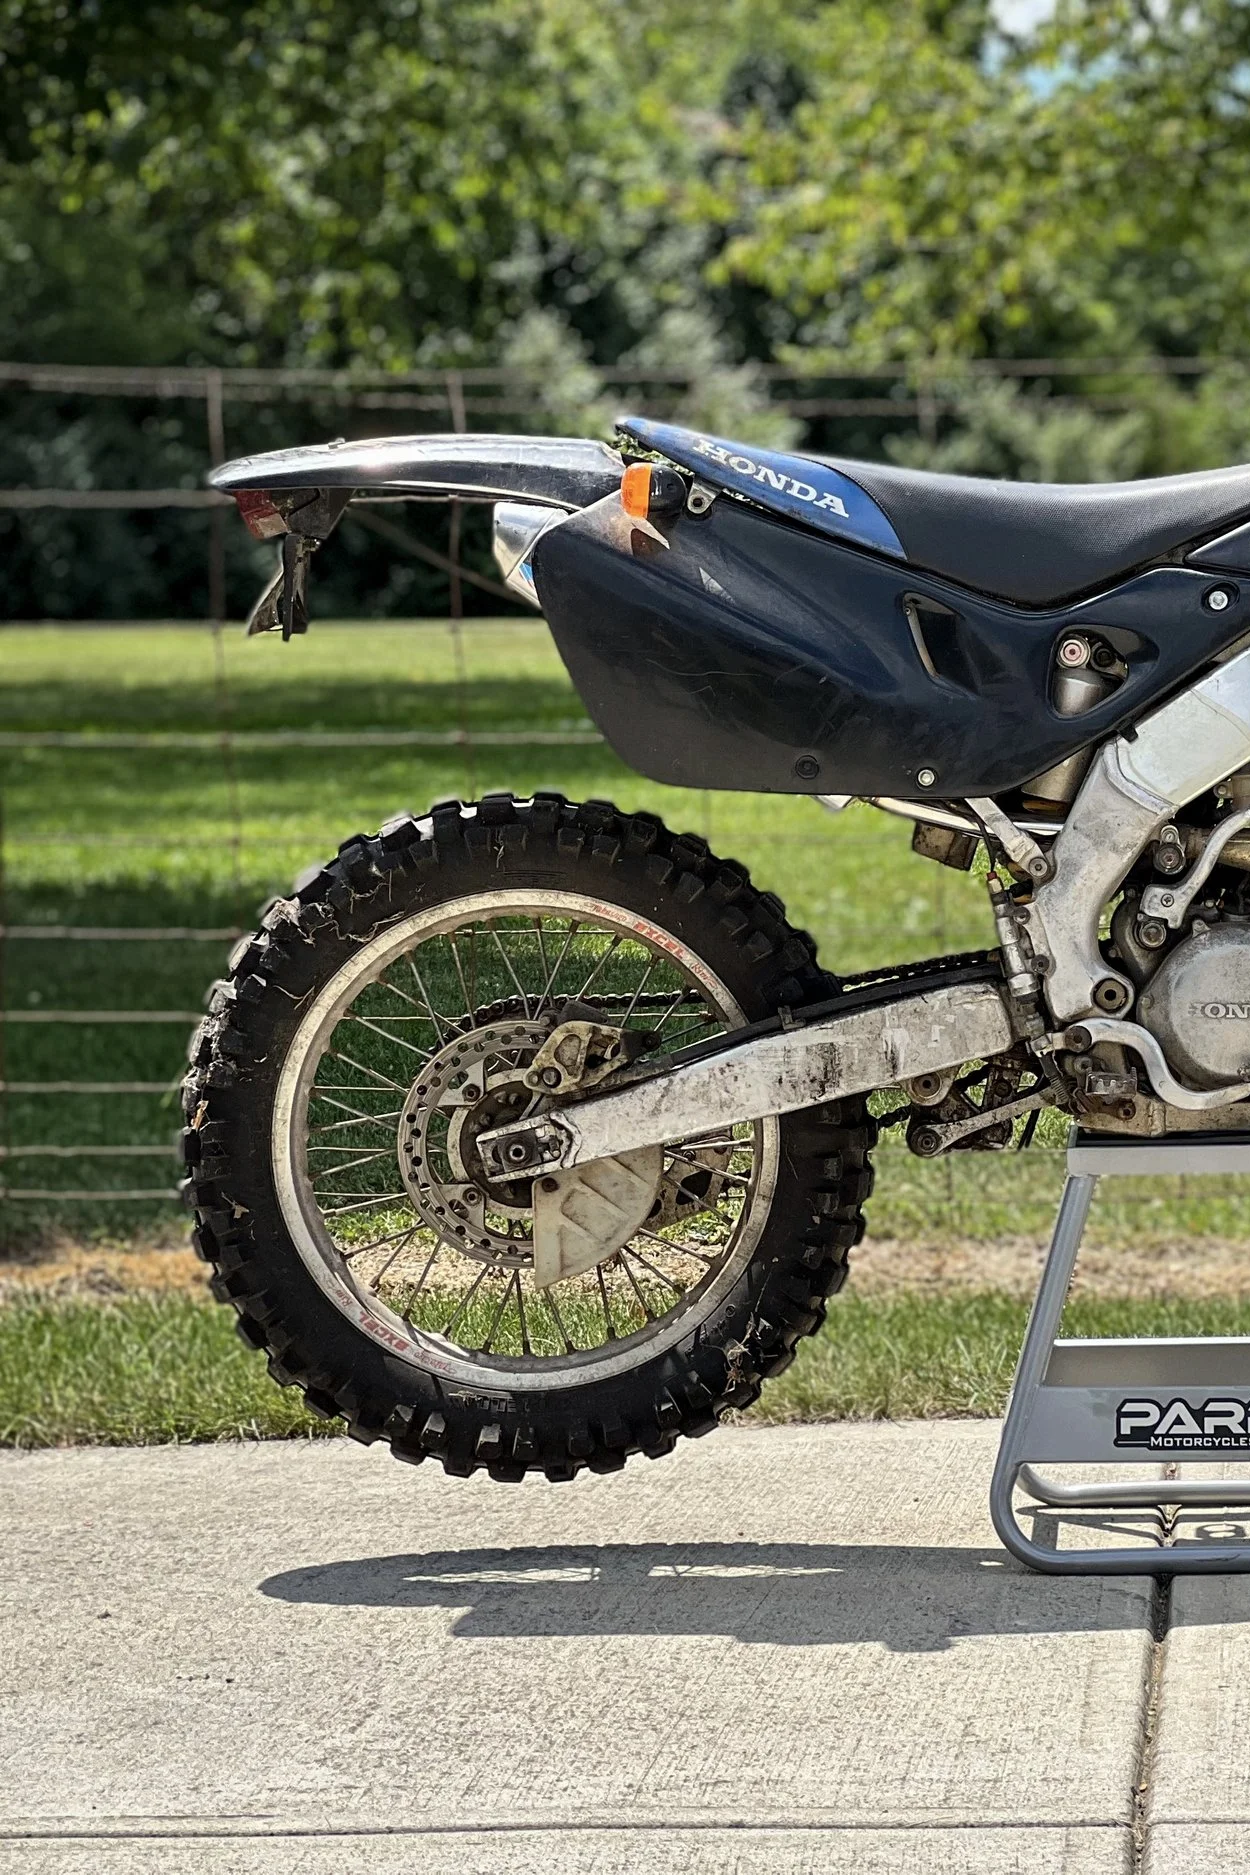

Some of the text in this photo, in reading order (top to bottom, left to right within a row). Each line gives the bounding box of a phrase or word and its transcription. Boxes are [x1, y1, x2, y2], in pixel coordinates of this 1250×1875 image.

[692, 439, 849, 519] HONDA
[632, 921, 685, 960] EXCEL
[359, 1310, 410, 1352] EXCEL
